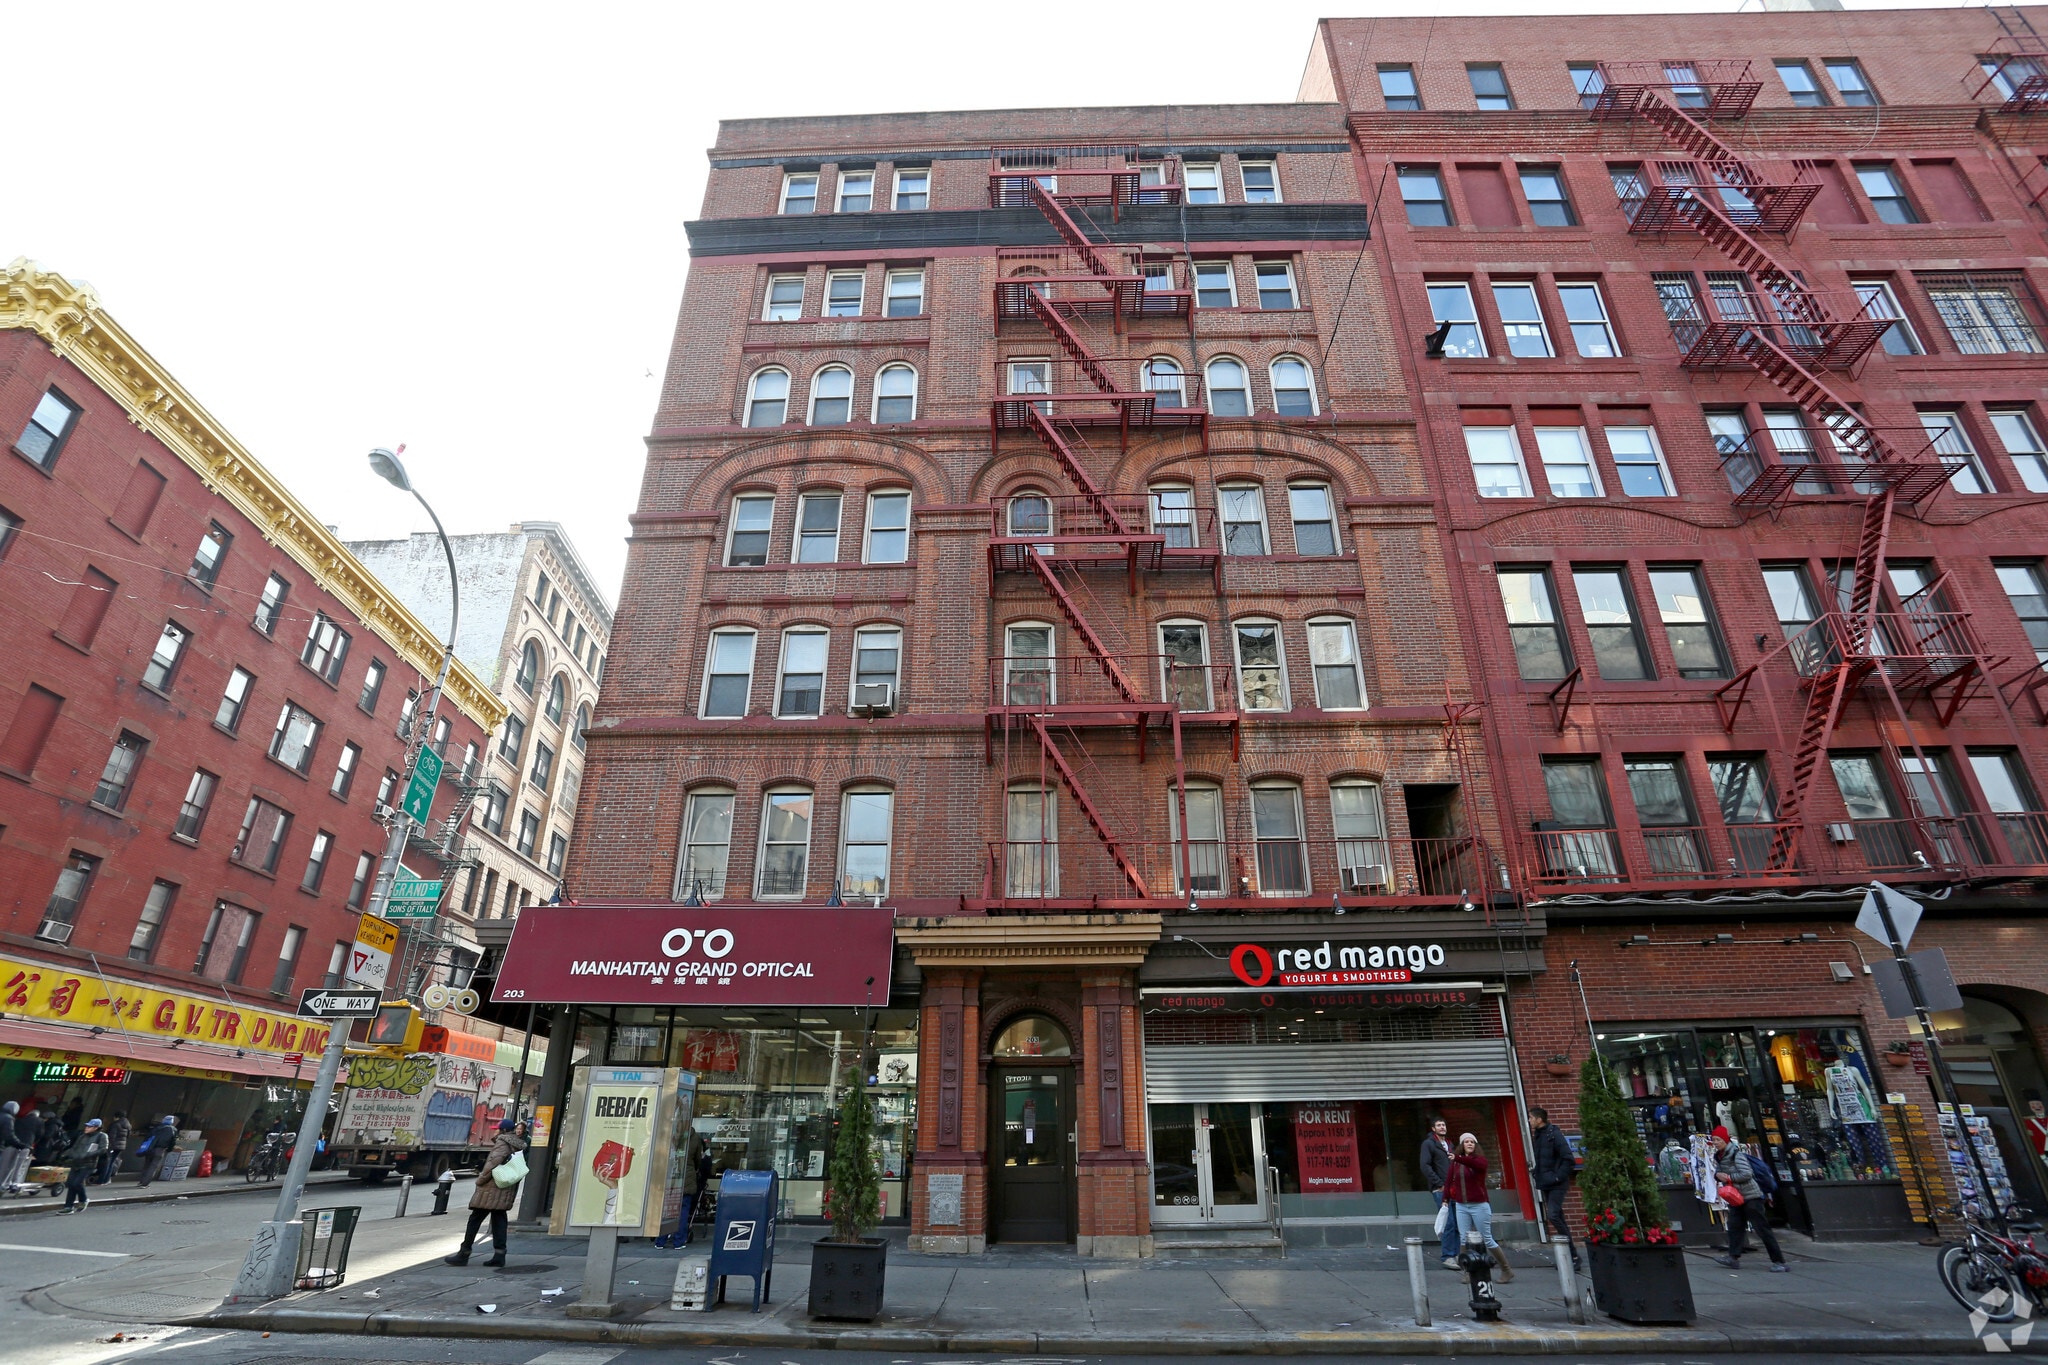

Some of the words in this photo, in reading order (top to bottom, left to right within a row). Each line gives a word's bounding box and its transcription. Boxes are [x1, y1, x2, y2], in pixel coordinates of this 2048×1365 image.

[414, 782, 428, 798] Bridge
[392, 882, 429, 897] GRAND
[429, 882, 441, 891] ST
[388, 905, 407, 913] SONS
[407, 905, 416, 913] OF
[416, 905, 435, 913] ITALY
[362, 918, 386, 935] TURNING
[360, 930, 383, 946] VEHICLES
[1277, 940, 1332, 971] red
[1339, 944, 1446, 973] mango
[365, 962, 372, 972] TO
[570, 960, 671, 976] MANHATTAN
[675, 961, 738, 977] GRAND
[742, 962, 814, 977] OPTICAL
[650, 976, 732, 986] 美視眼鏡
[1285, 973, 1327, 983] YOGURT
[1332, 973, 1338, 982] &
[1343, 971, 1406, 982] SMOOTHIES
[6, 970, 82, 1017] 公司
[502, 989, 525, 998] 203
[1310, 994, 1363, 1005] YOGURT
[1371, 993, 1379, 1004] &
[1385, 992, 1467, 1004] SMOOTHIES
[313, 998, 338, 1009] ONE
[346, 998, 371, 1009] WAY
[1162, 996, 1183, 1007] red
[1186, 996, 1226, 1009] mango
[612, 1071, 643, 1081] TITAN
[1711, 1077, 1728, 1089] 201
[595, 1096, 649, 1118] REBAG
[1298, 1110, 1321, 1124] FOR
[1324, 1110, 1351, 1124] RENT
[1324, 1177, 1353, 1185] Management
[1477, 1280, 1495, 1298] 20
